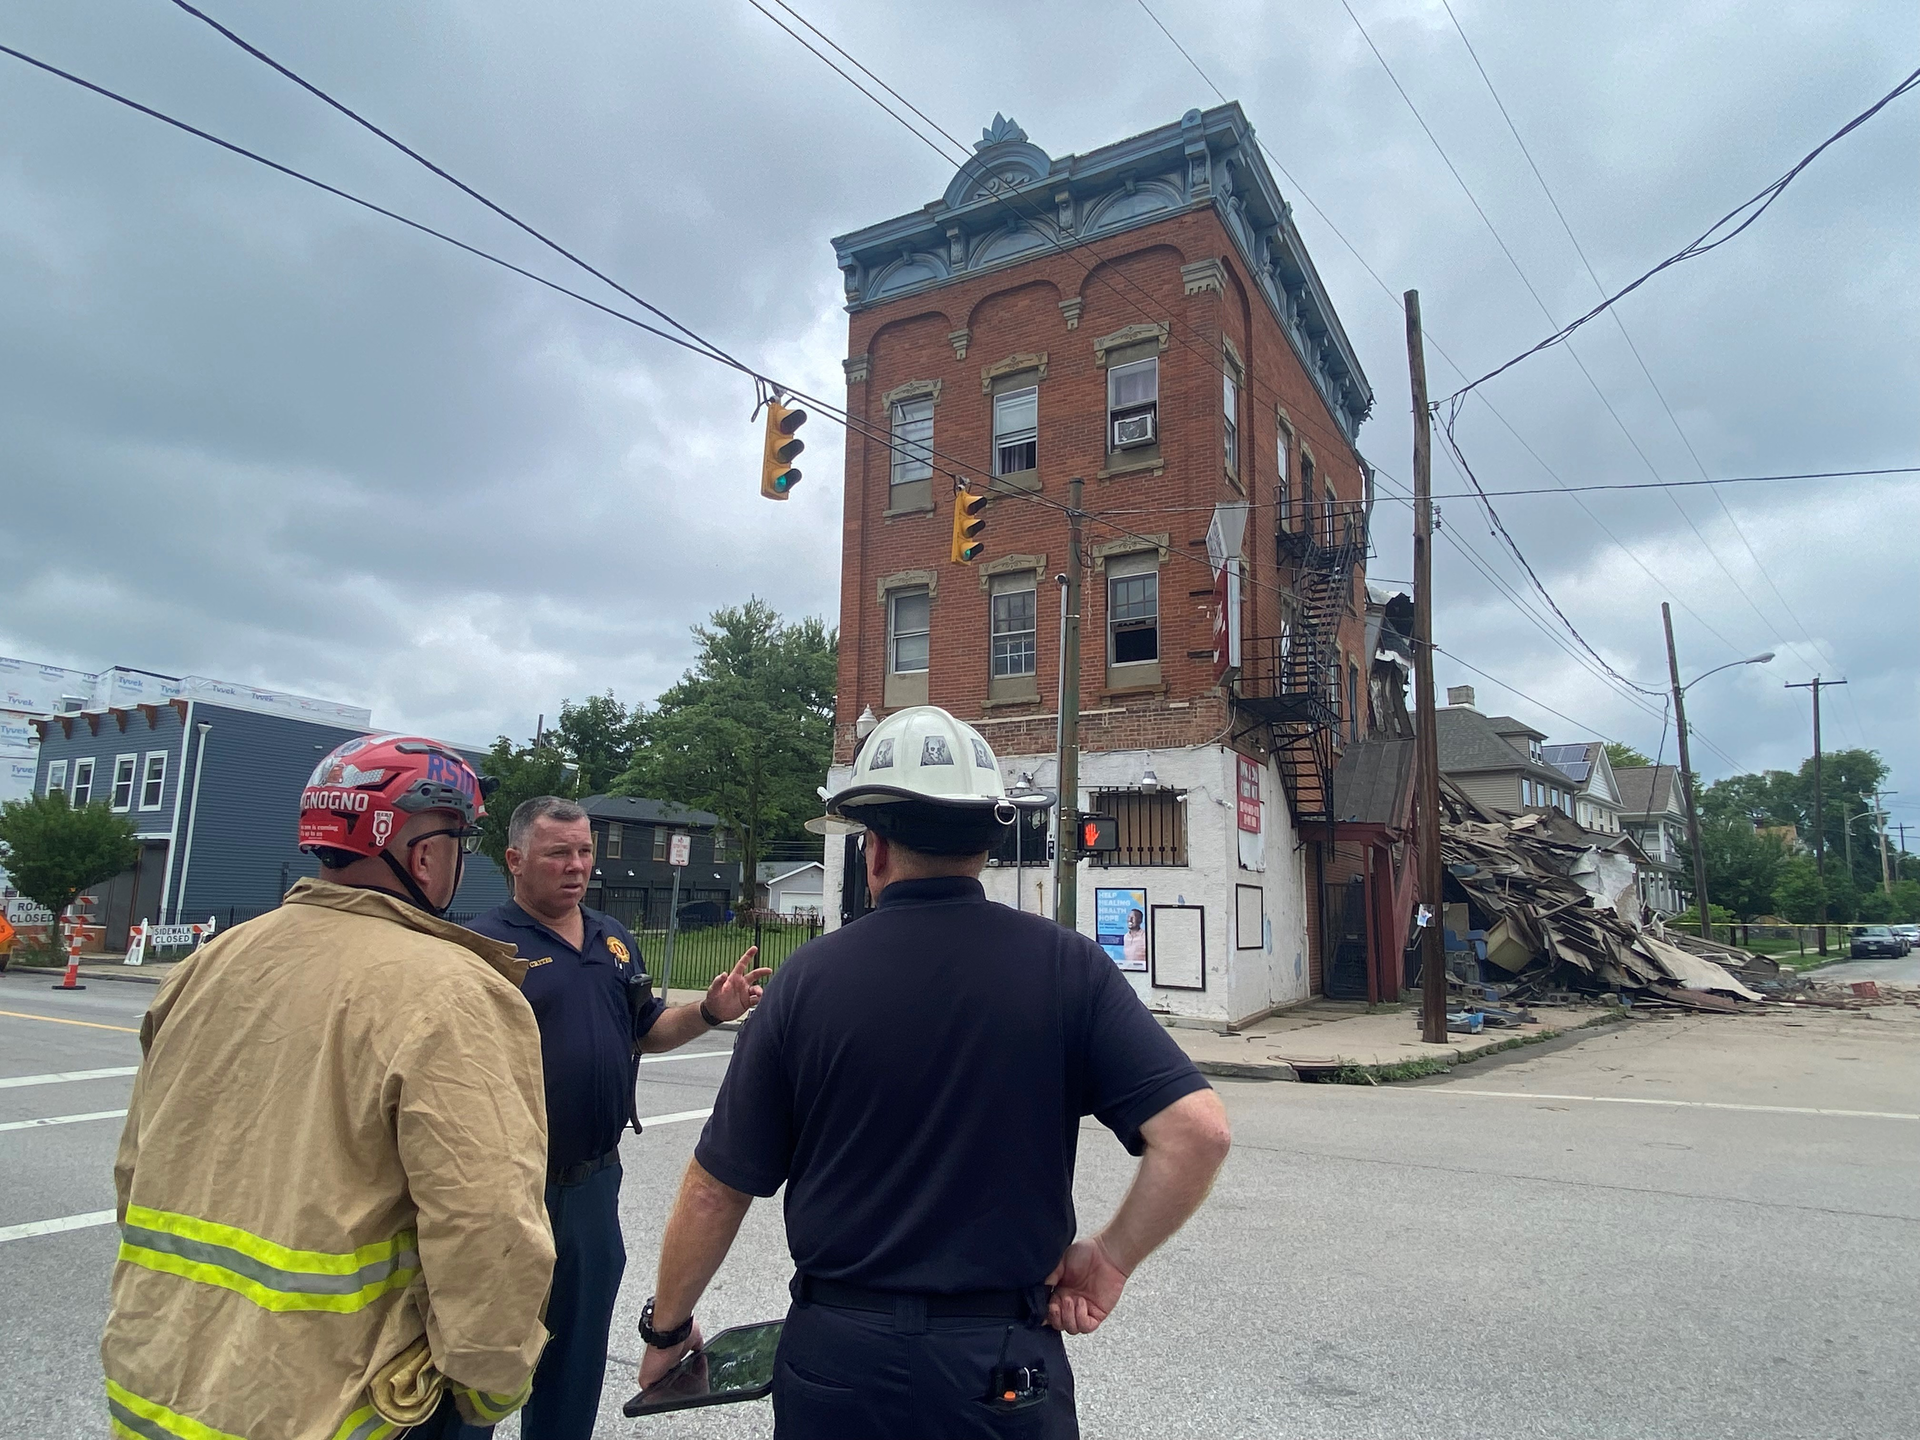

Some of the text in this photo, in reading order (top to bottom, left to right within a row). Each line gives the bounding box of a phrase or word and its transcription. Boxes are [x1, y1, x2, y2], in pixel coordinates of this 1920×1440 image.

[119, 676, 143, 688] Tyvek
[160, 684, 181, 695] Tyve
[212, 684, 236, 696] Tyvek
[8, 695, 33, 707] Tyvek
[251, 692, 274, 702] Tyvek
[1, 725, 28, 736] Tyvek
[10, 913, 55, 923] CLOSED
[154, 927, 192, 936] SIDEWALK
[155, 934, 190, 944] CLOSED
